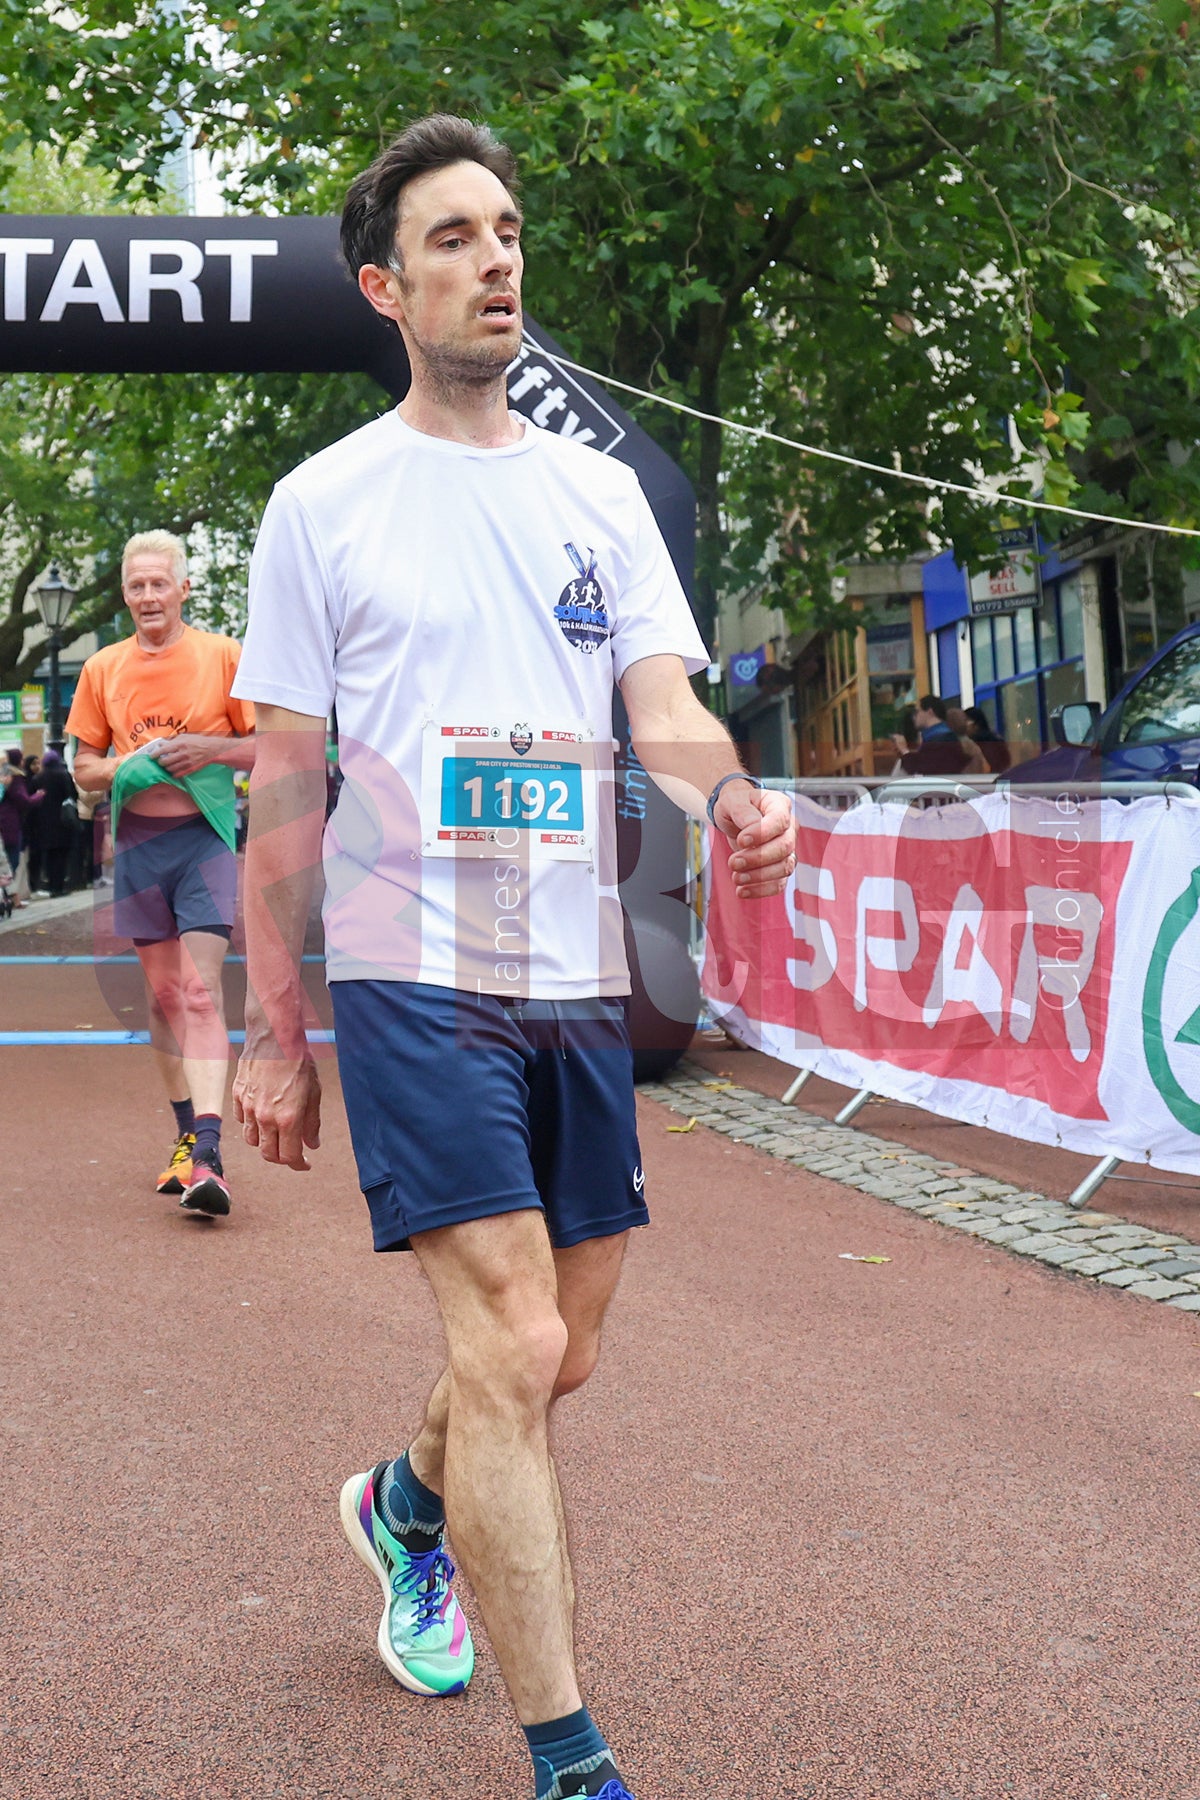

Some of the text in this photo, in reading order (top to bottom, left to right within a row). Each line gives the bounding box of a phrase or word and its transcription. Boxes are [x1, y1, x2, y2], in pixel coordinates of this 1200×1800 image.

[990, 582, 1016, 594] SELL
[453, 727, 488, 736] SPAR
[551, 731, 576, 742] SPAR
[617, 726, 647, 820] timin
[463, 776, 569, 821] 1192
[450, 831, 486, 840] SPAR
[551, 835, 578, 844] SPAR
[785, 862, 1104, 1063] SPAR
